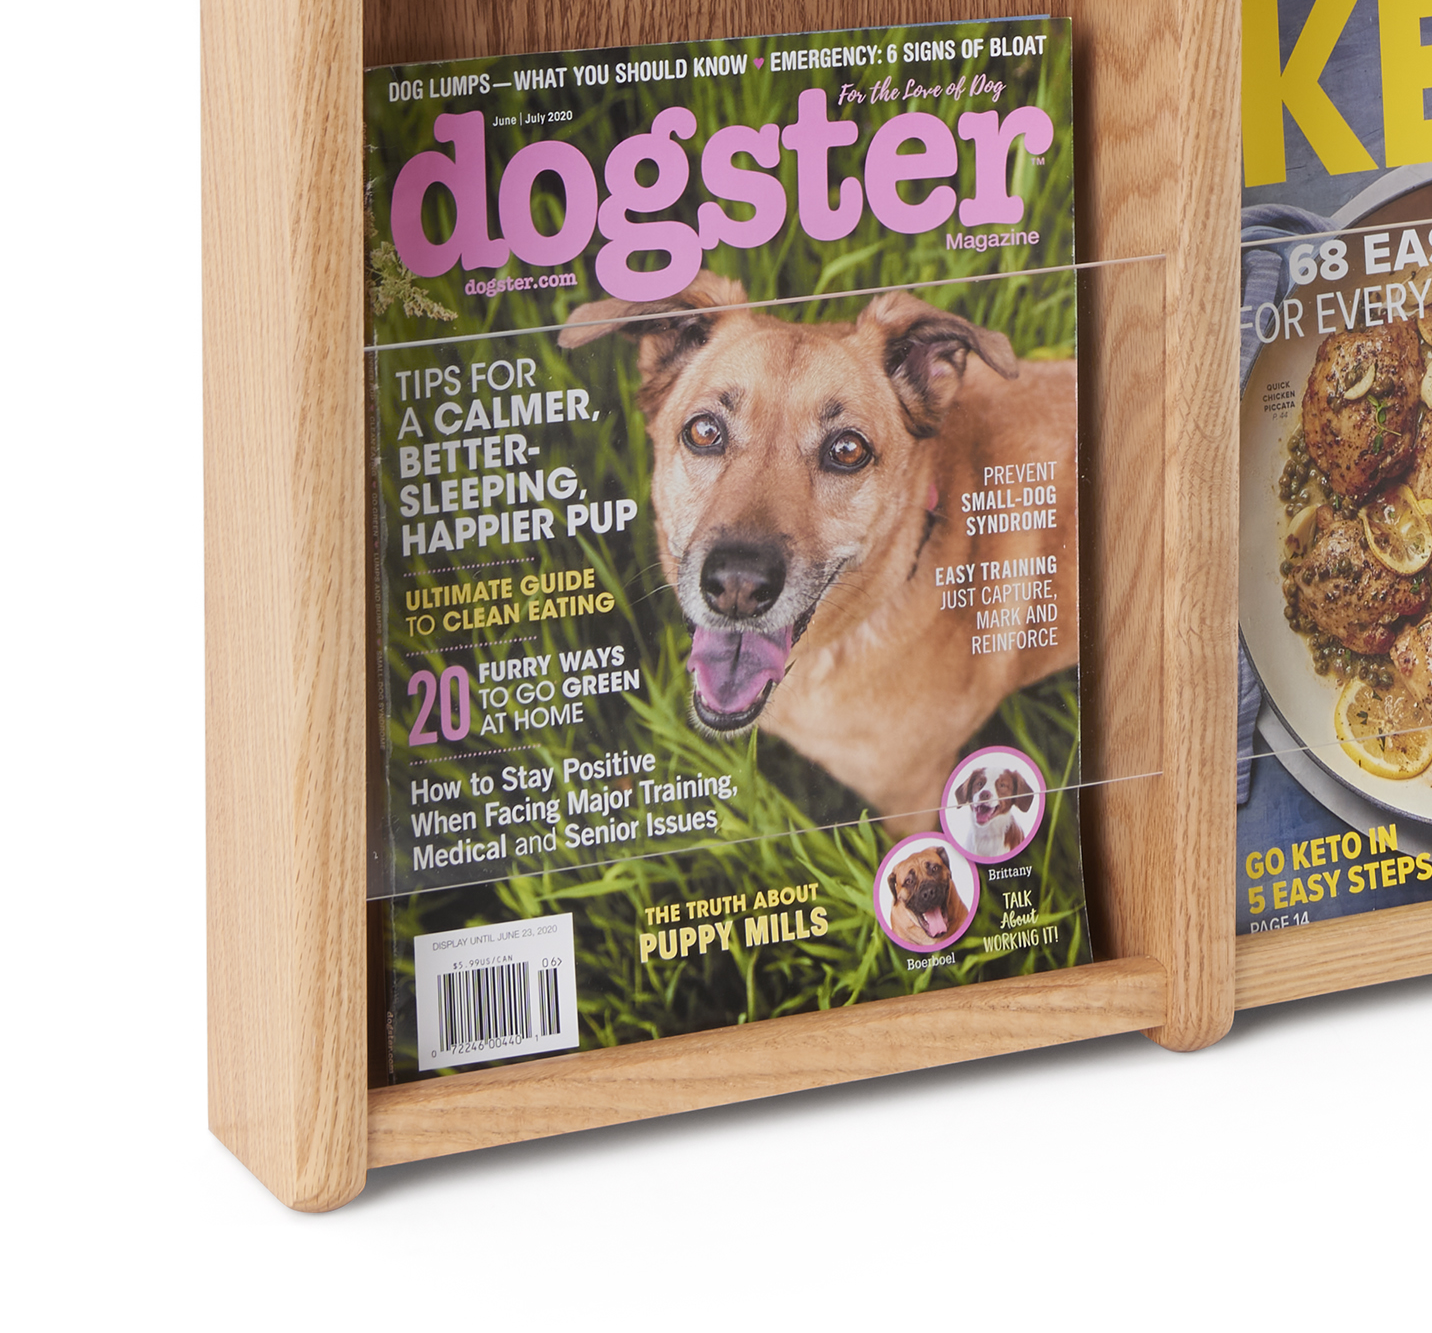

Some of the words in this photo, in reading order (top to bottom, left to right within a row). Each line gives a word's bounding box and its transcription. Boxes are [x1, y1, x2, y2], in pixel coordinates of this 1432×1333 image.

[769, 45, 883, 73] EMERGENCY:
[886, 43, 898, 62] 6
[903, 41, 954, 62] SIGNS
[962, 39, 984, 60] OF
[989, 34, 1047, 57] BLOAT
[389, 87, 1054, 302] dogster
[945, 229, 1039, 253] Magazine
[1289, 241, 1349, 285] 68
[465, 271, 577, 296] dogster.com
[1317, 278, 1432, 334] EVERY
[395, 365, 461, 401] TIPS
[471, 358, 536, 393] FOR
[984, 461, 1057, 486] PREVENT
[402, 508, 555, 557] HAPPIER
[567, 499, 637, 537] PUP
[981, 555, 1057, 580] TRAINING
[479, 655, 551, 683] FURRY
[559, 646, 625, 673] WAYS
[407, 665, 471, 747] 20
[413, 834, 507, 871] Medical
[515, 829, 557, 857] and
[565, 819, 639, 849] Senior
[647, 808, 718, 836] Issues
[988, 865, 1032, 882] Brittany
[1273, 869, 1341, 910] EASY
[470, 935, 495, 945] UNTIL
[497, 930, 520, 941] JUNE
[537, 925, 557, 935] 2020
[639, 920, 733, 963] PUPPY
[745, 906, 829, 947] MILLS
[907, 952, 955, 971] Boerboel
